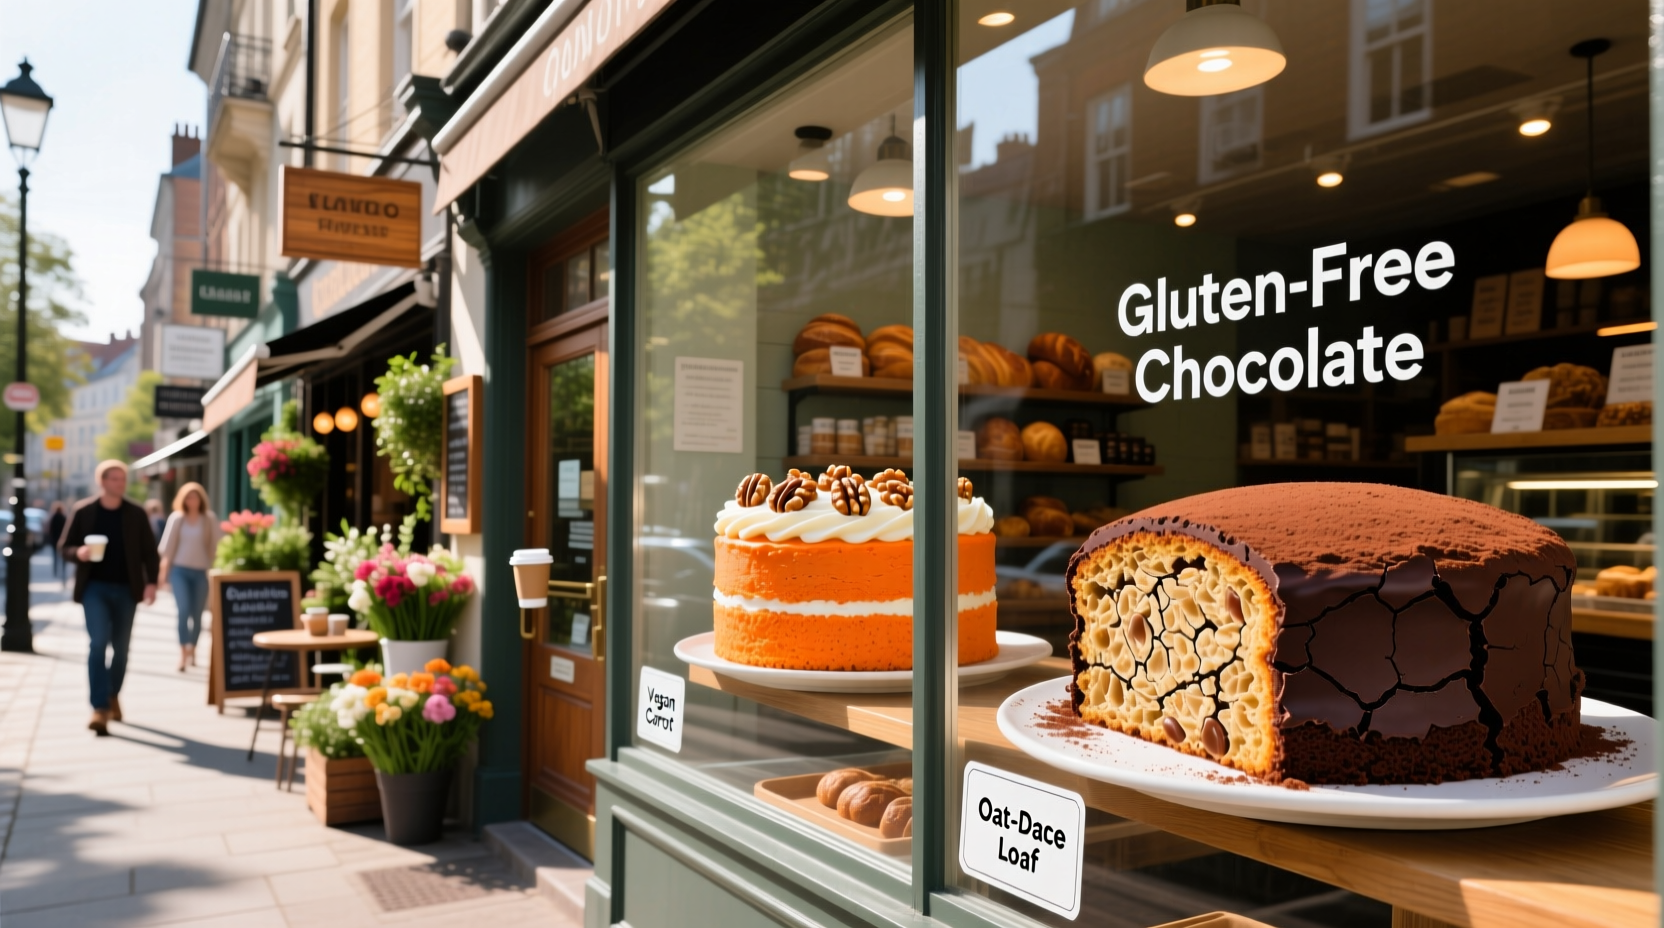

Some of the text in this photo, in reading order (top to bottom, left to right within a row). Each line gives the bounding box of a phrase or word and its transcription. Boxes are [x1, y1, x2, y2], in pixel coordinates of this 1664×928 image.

[1118, 241, 1455, 337] Gluten-Free
[1135, 326, 1424, 404] Chocolate
[978, 796, 1066, 850] Oat-Dace
[998, 836, 1040, 874] Loaf
